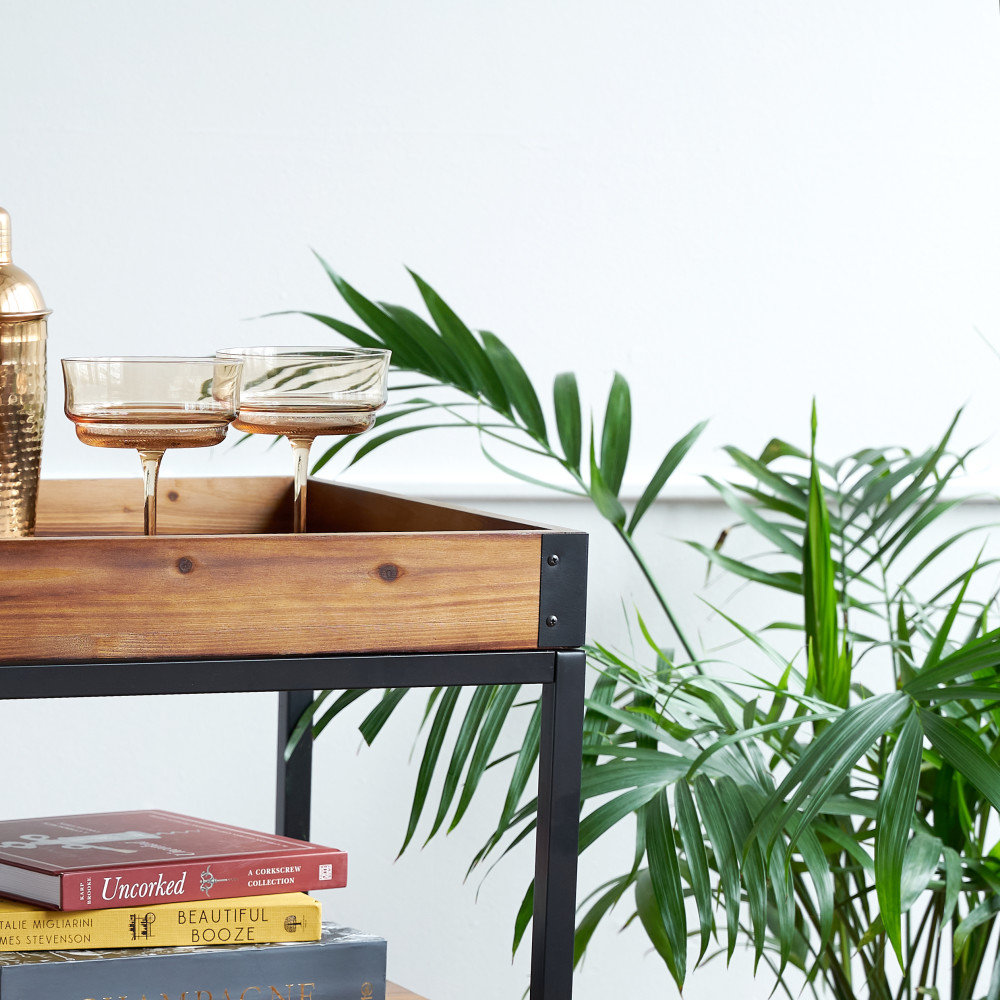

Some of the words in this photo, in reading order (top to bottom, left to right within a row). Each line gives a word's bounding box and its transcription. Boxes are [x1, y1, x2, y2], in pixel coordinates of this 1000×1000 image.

[255, 866, 302, 876] CORKSCREW
[101, 871, 188, 901] Uncorked
[247, 877, 295, 887] COLLECTION
[178, 908, 269, 925] BEAUTIFUL
[32, 918, 93, 930] MIGLIARINI
[26, 934, 91, 945] STEVENSON
[191, 927, 255, 943] BOOZE
